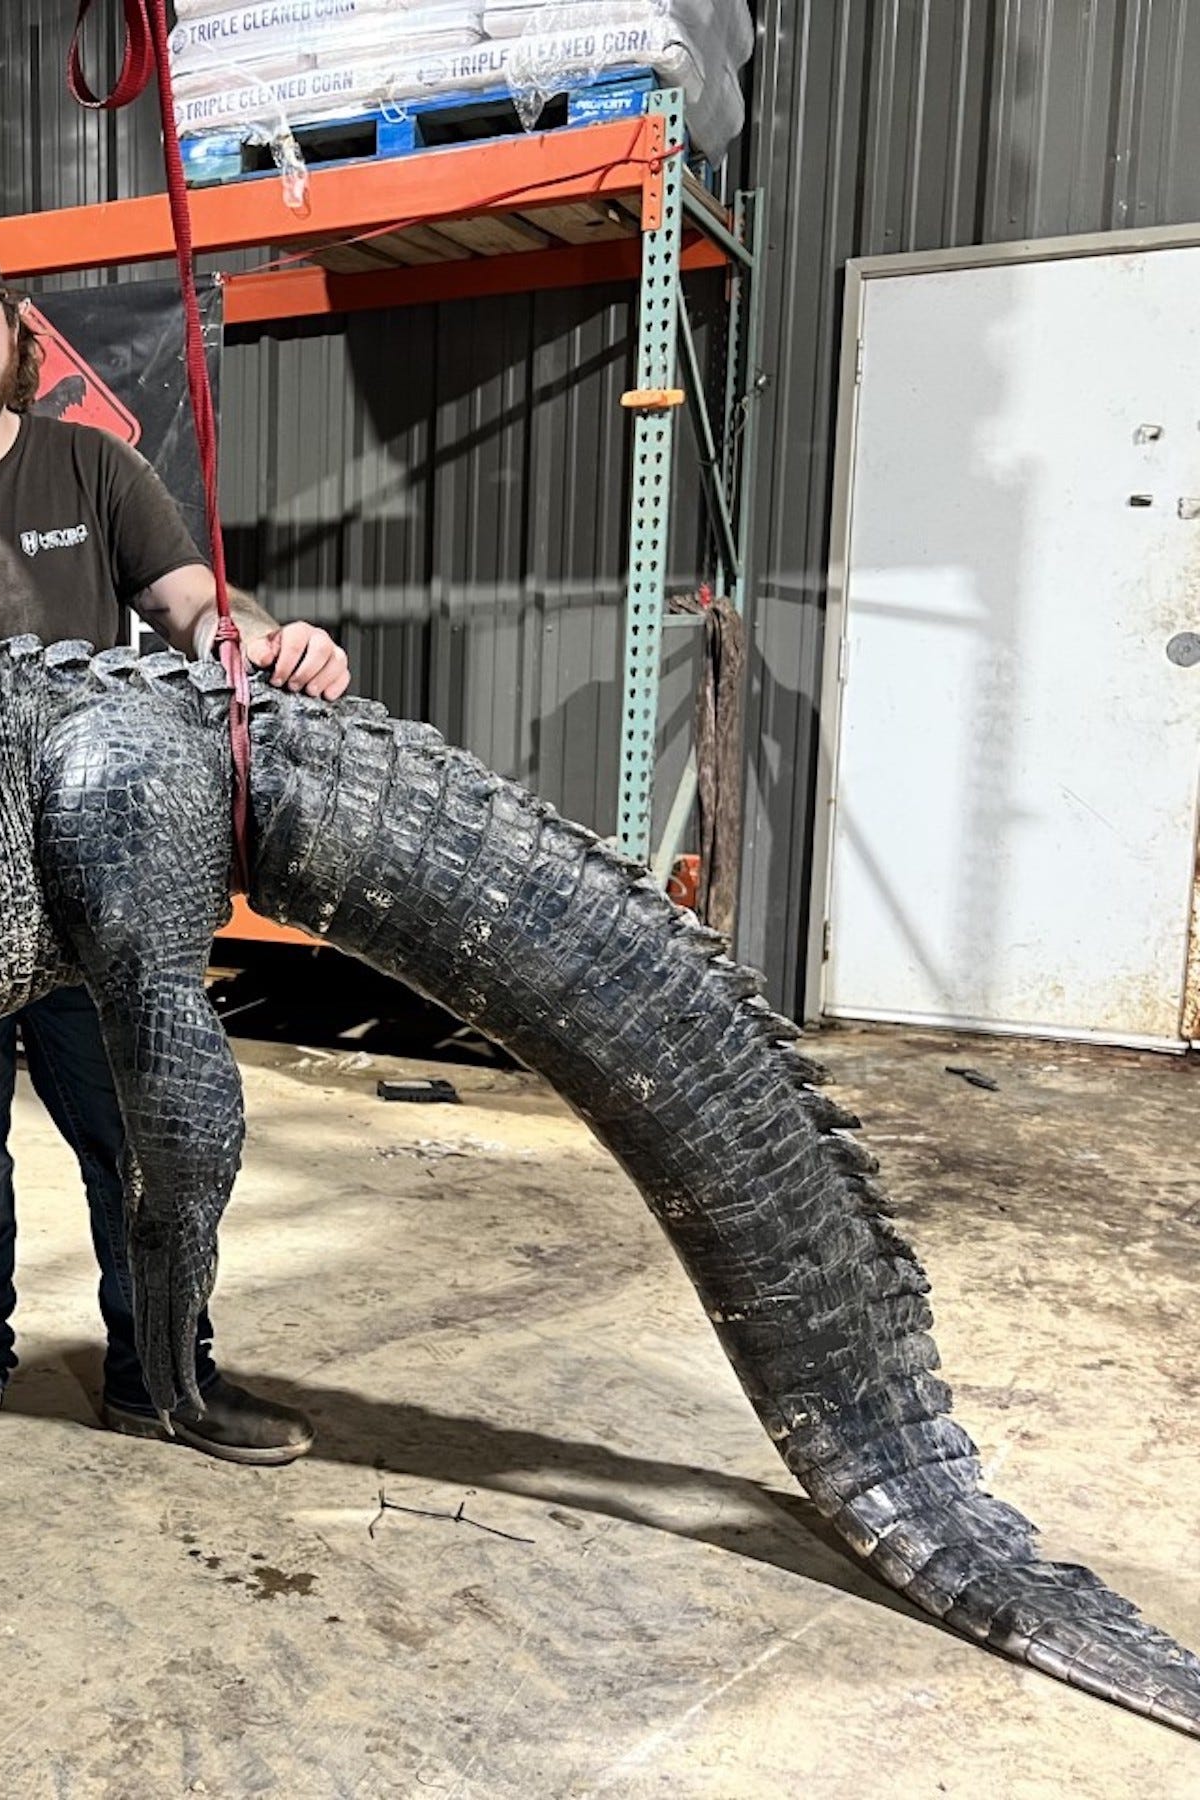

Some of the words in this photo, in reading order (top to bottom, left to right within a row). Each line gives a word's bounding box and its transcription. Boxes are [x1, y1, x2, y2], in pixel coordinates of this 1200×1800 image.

[190, 15, 238, 44] TRIPLE
[243, 2, 311, 32] CLEANED
[186, 93, 235, 121] TRIPLE
[312, 70, 354, 94] CORN
